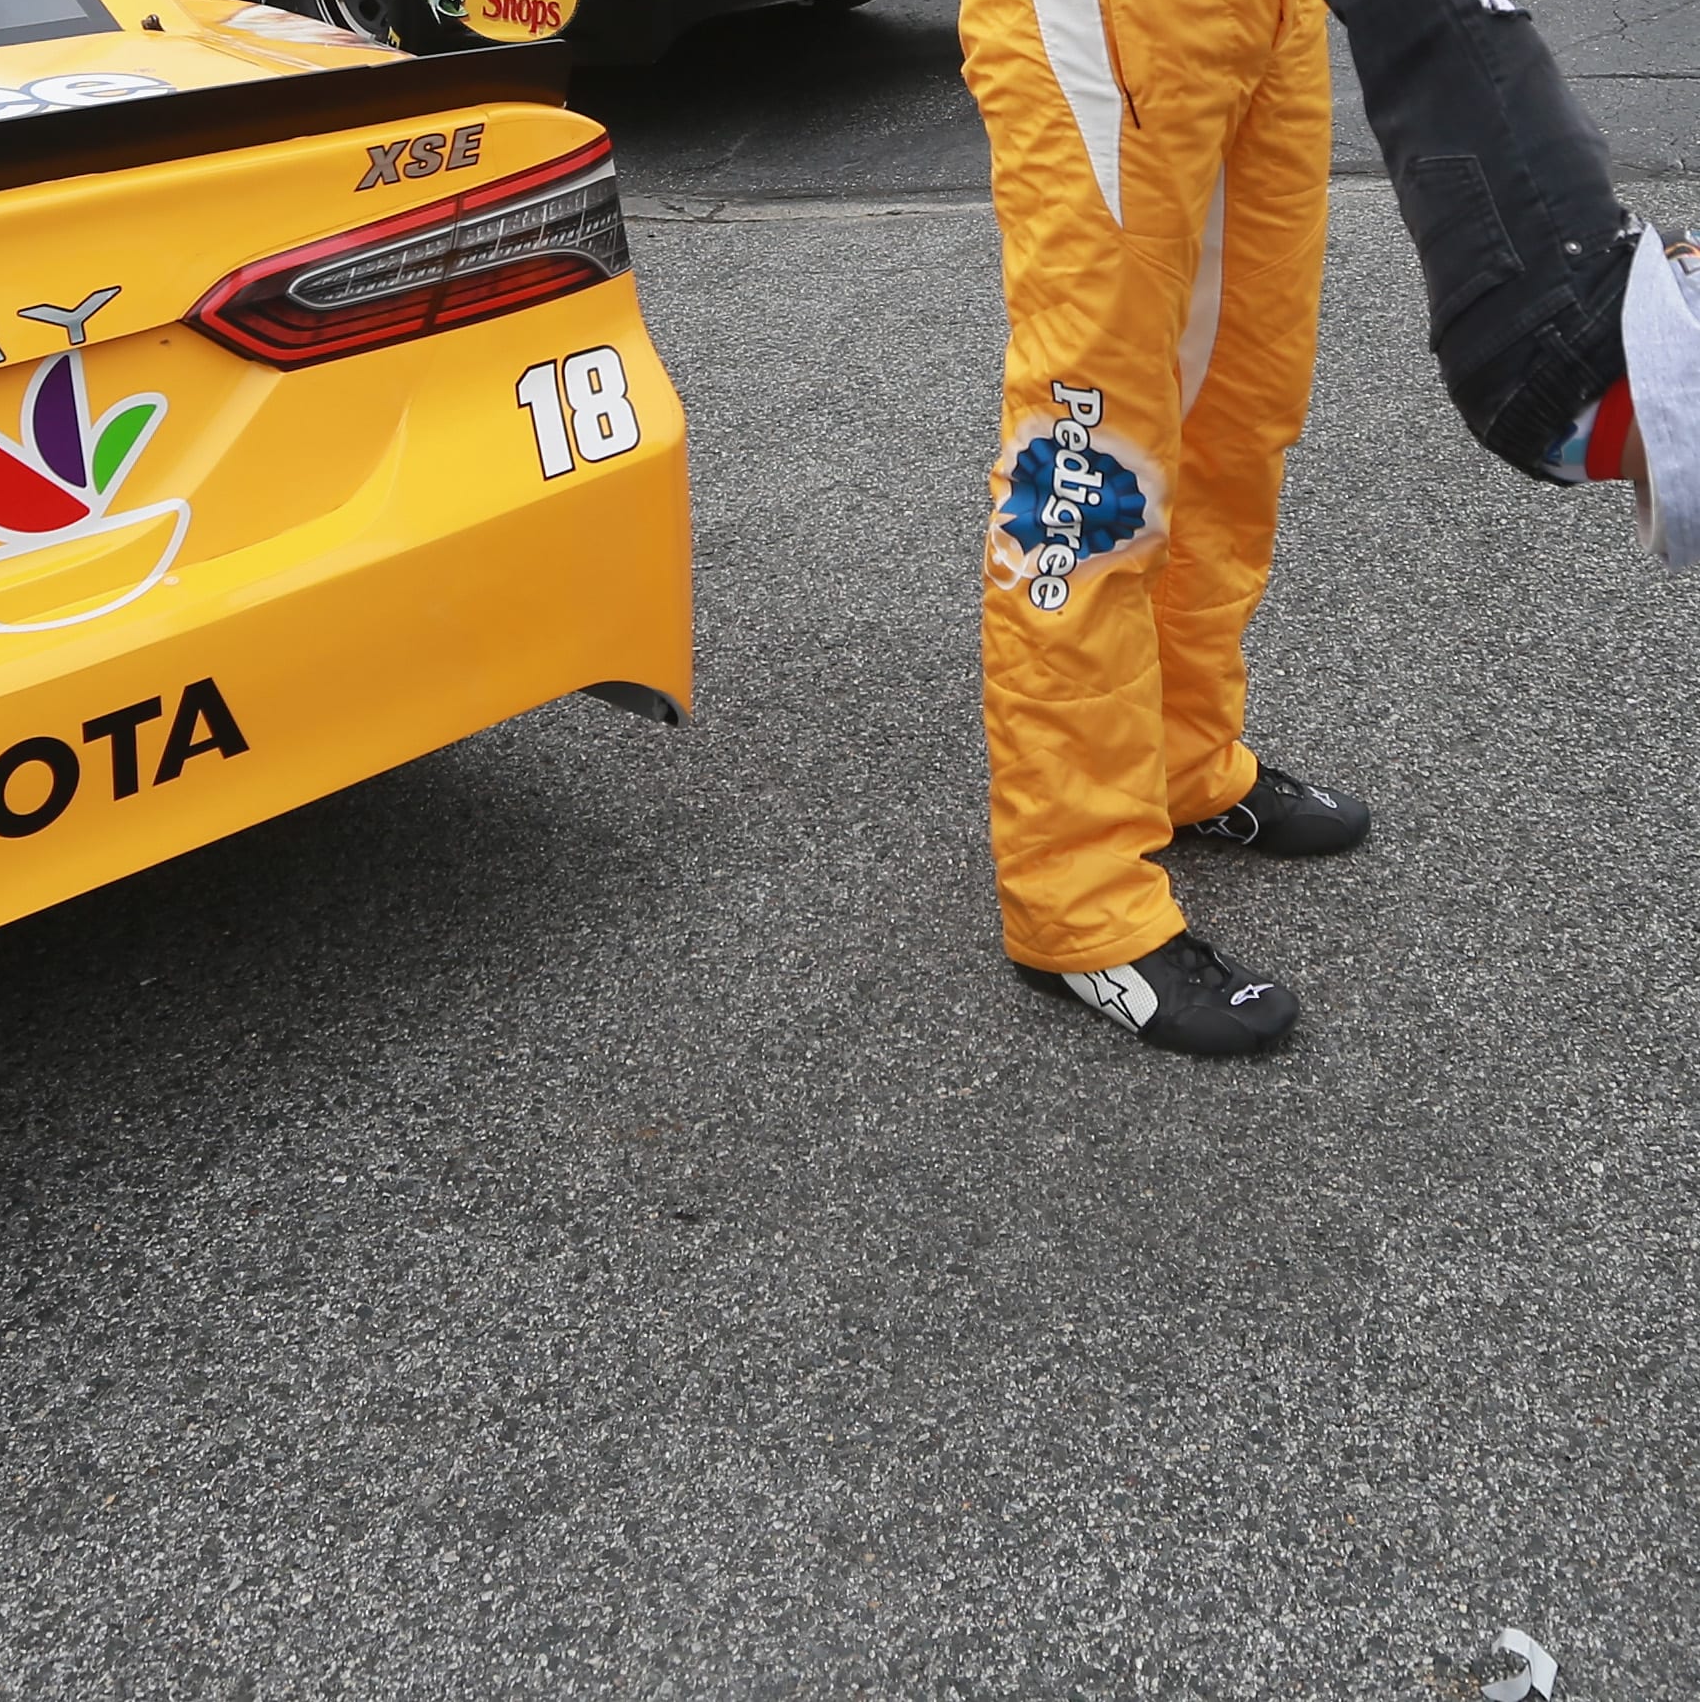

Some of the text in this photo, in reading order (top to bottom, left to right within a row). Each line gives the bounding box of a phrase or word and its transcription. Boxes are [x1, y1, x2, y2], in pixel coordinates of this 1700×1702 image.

[354, 123, 485, 191] XSE
[516, 345, 642, 481] 18
[1027, 379, 1102, 612] Pedigree
